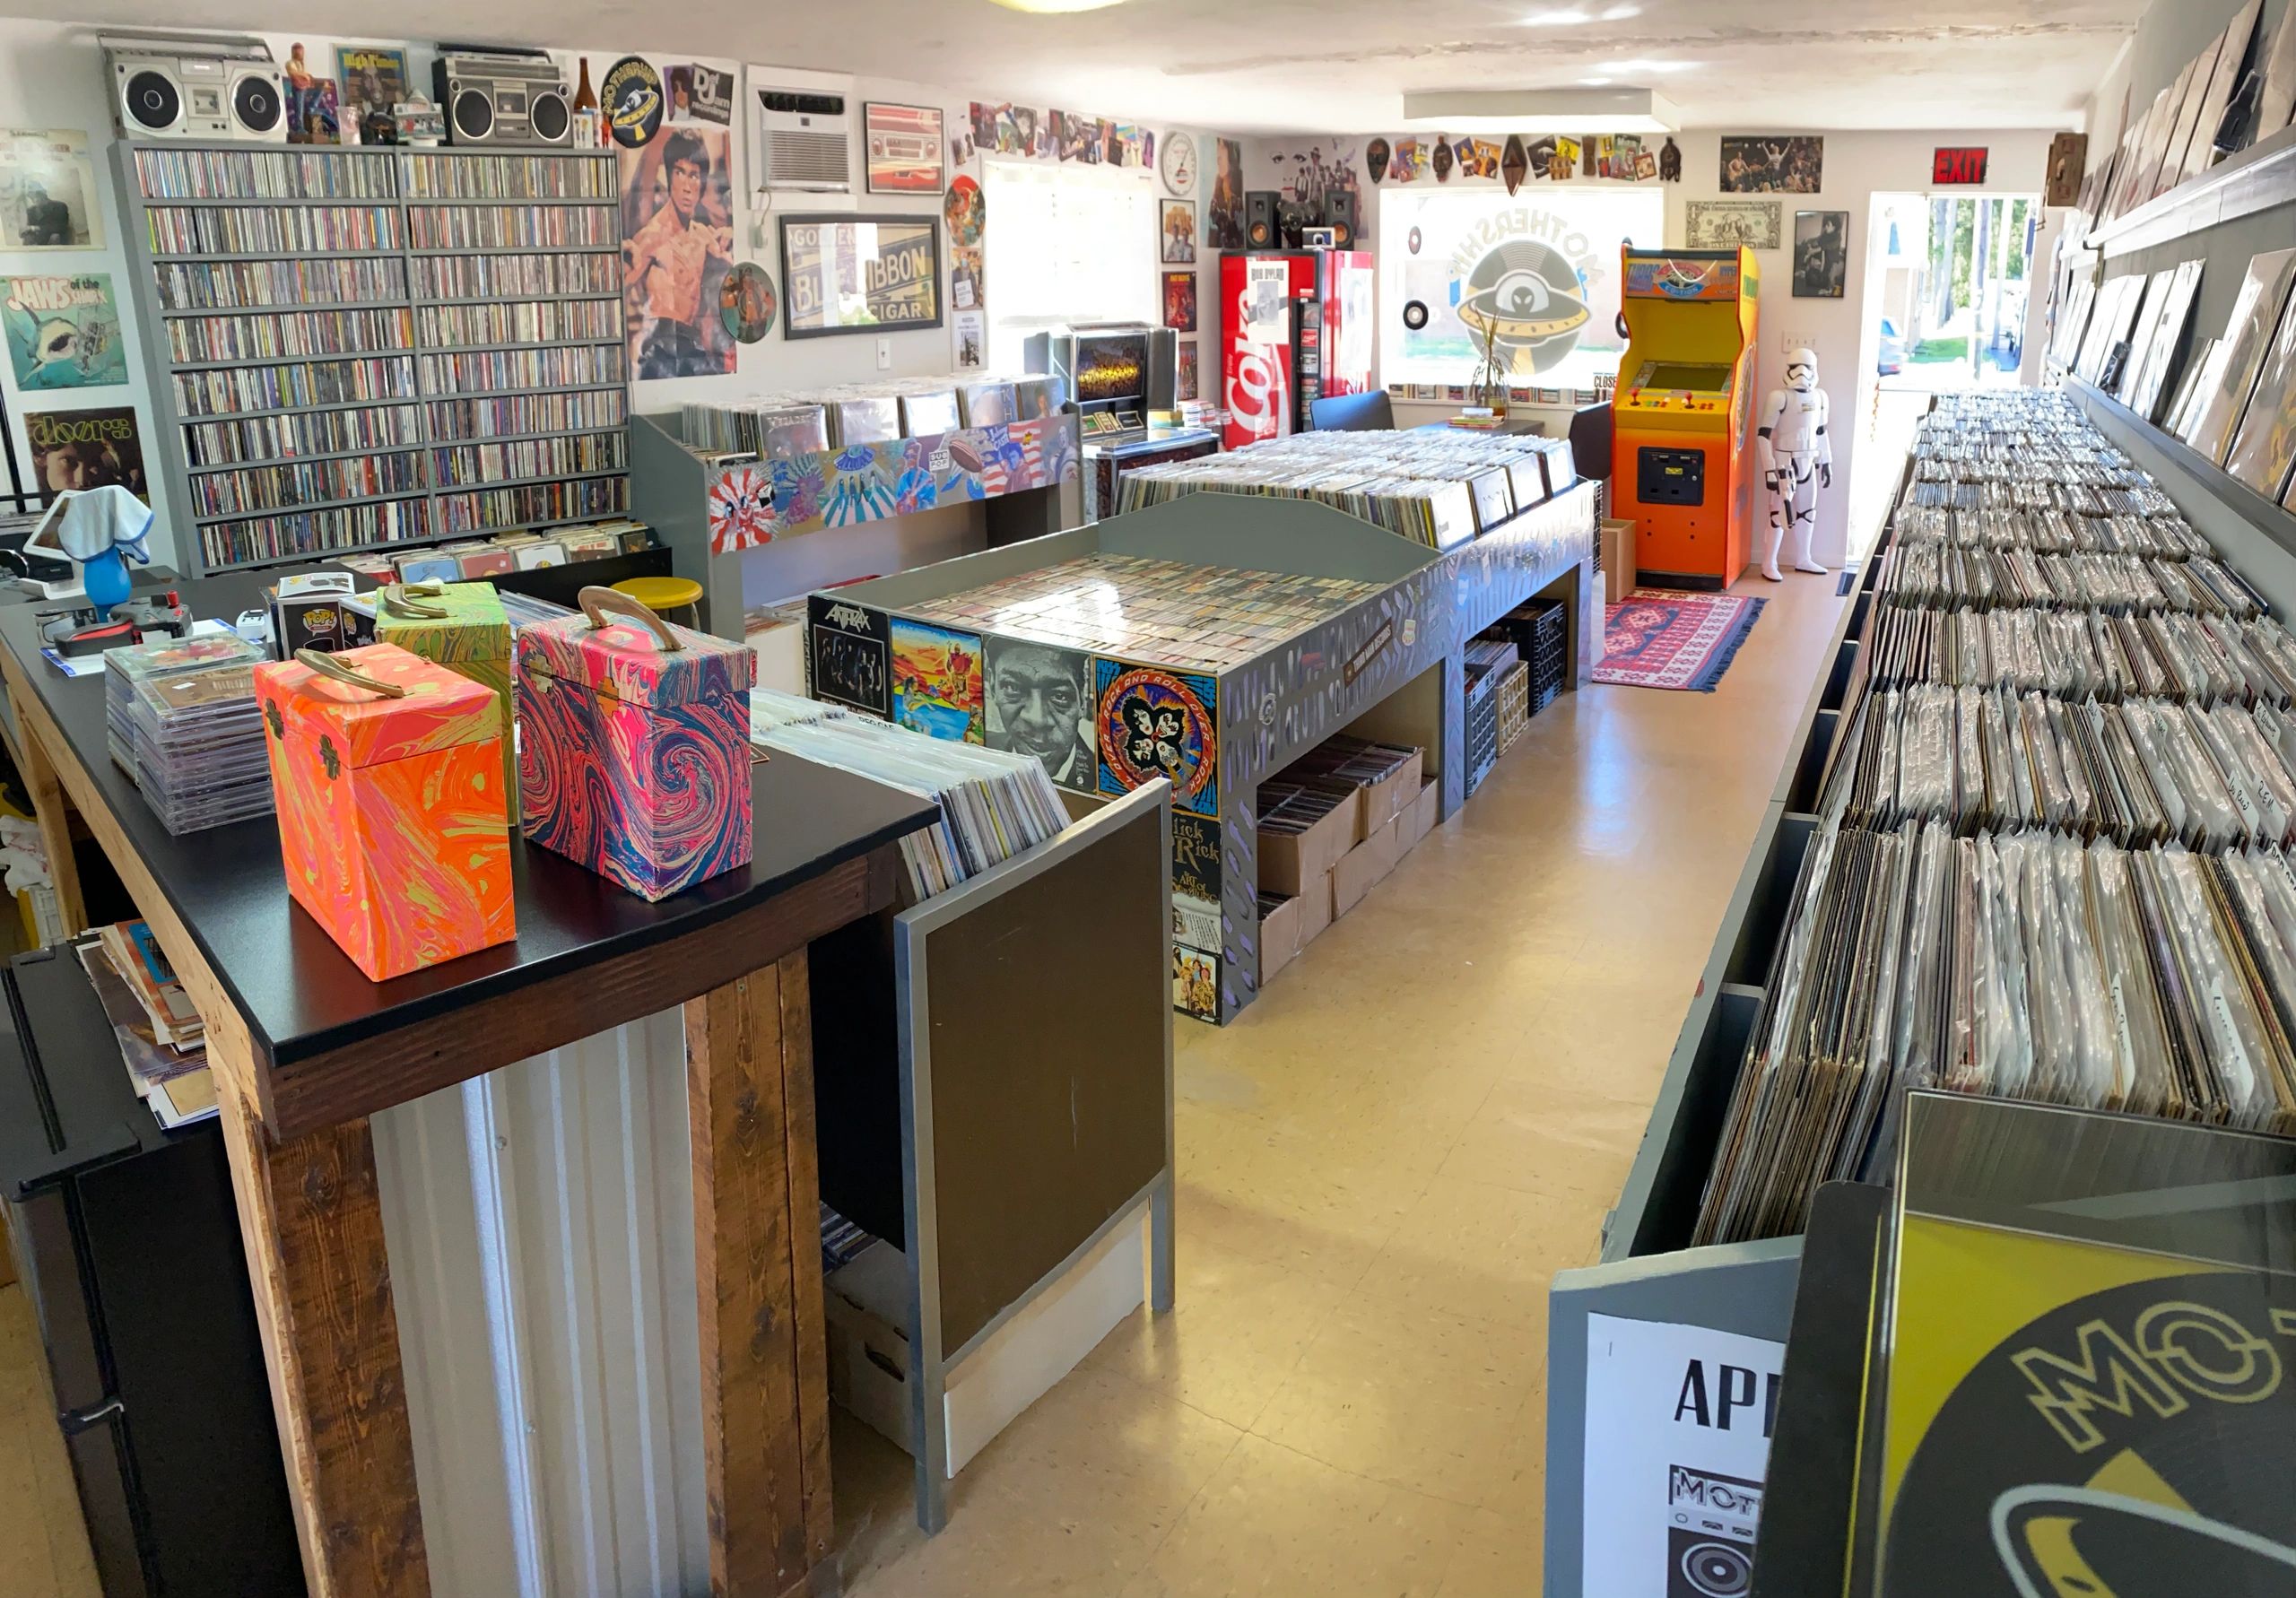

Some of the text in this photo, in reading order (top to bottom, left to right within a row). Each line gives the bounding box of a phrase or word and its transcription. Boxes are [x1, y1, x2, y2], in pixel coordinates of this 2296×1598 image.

[1934, 148, 1986, 183] EXIT
[795, 228, 857, 247] GOEN
[865, 245, 927, 293] IBBON
[6, 278, 71, 311] JAWS
[83, 278, 100, 290] the
[33, 415, 132, 447] doors
[930, 451, 948, 460] SUB
[930, 459, 948, 469] POP
[303, 608, 336, 626] POP!
[825, 604, 871, 633] ANTHRAX
[1104, 673, 1210, 741] ROCK AND ROLL OVER
[1189, 759, 1210, 791] ROCK
[1172, 817, 1204, 843] lick
[1173, 834, 1220, 874] Rick
